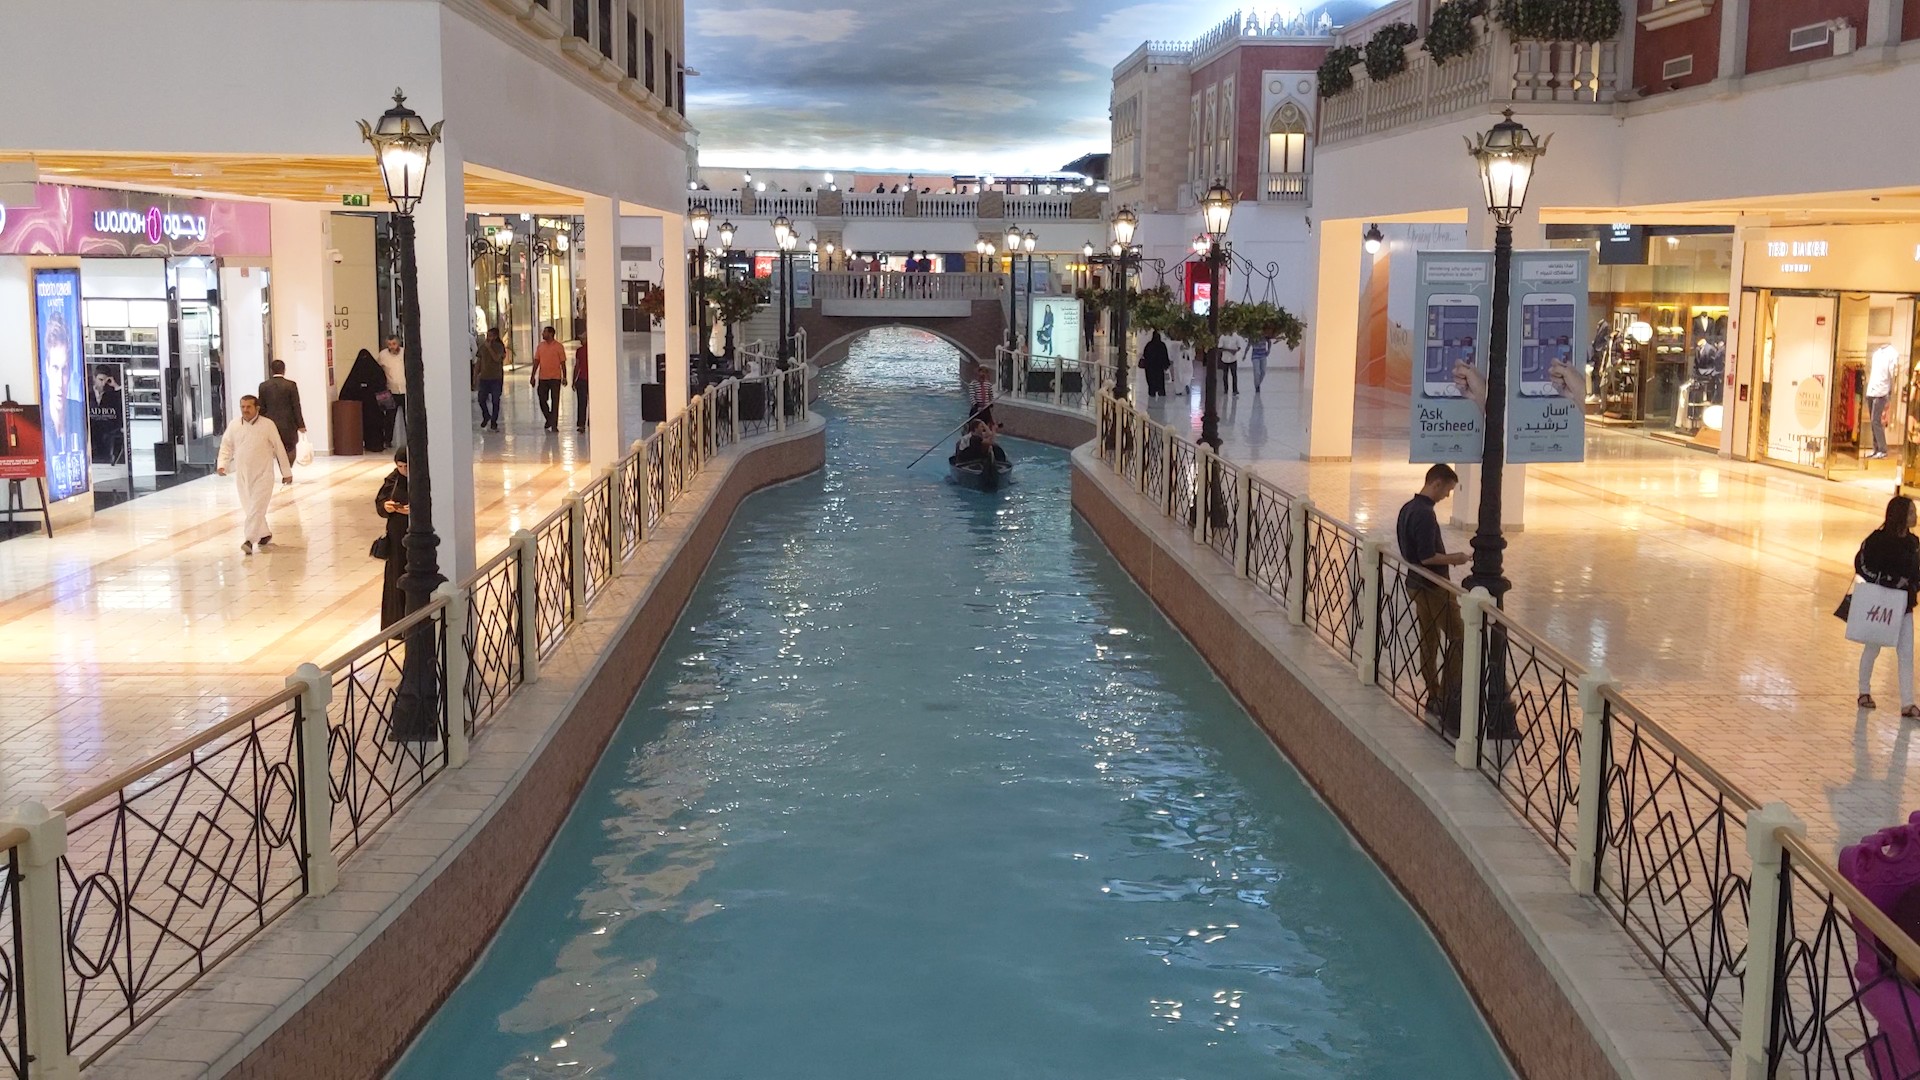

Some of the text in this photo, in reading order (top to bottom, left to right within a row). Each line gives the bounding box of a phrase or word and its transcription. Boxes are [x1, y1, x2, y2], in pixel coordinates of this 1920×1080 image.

[163, 214, 206, 241] وجوه
[1768, 241, 1828, 256] TED BAKER
[1781, 264, 1811, 272] LONDON
